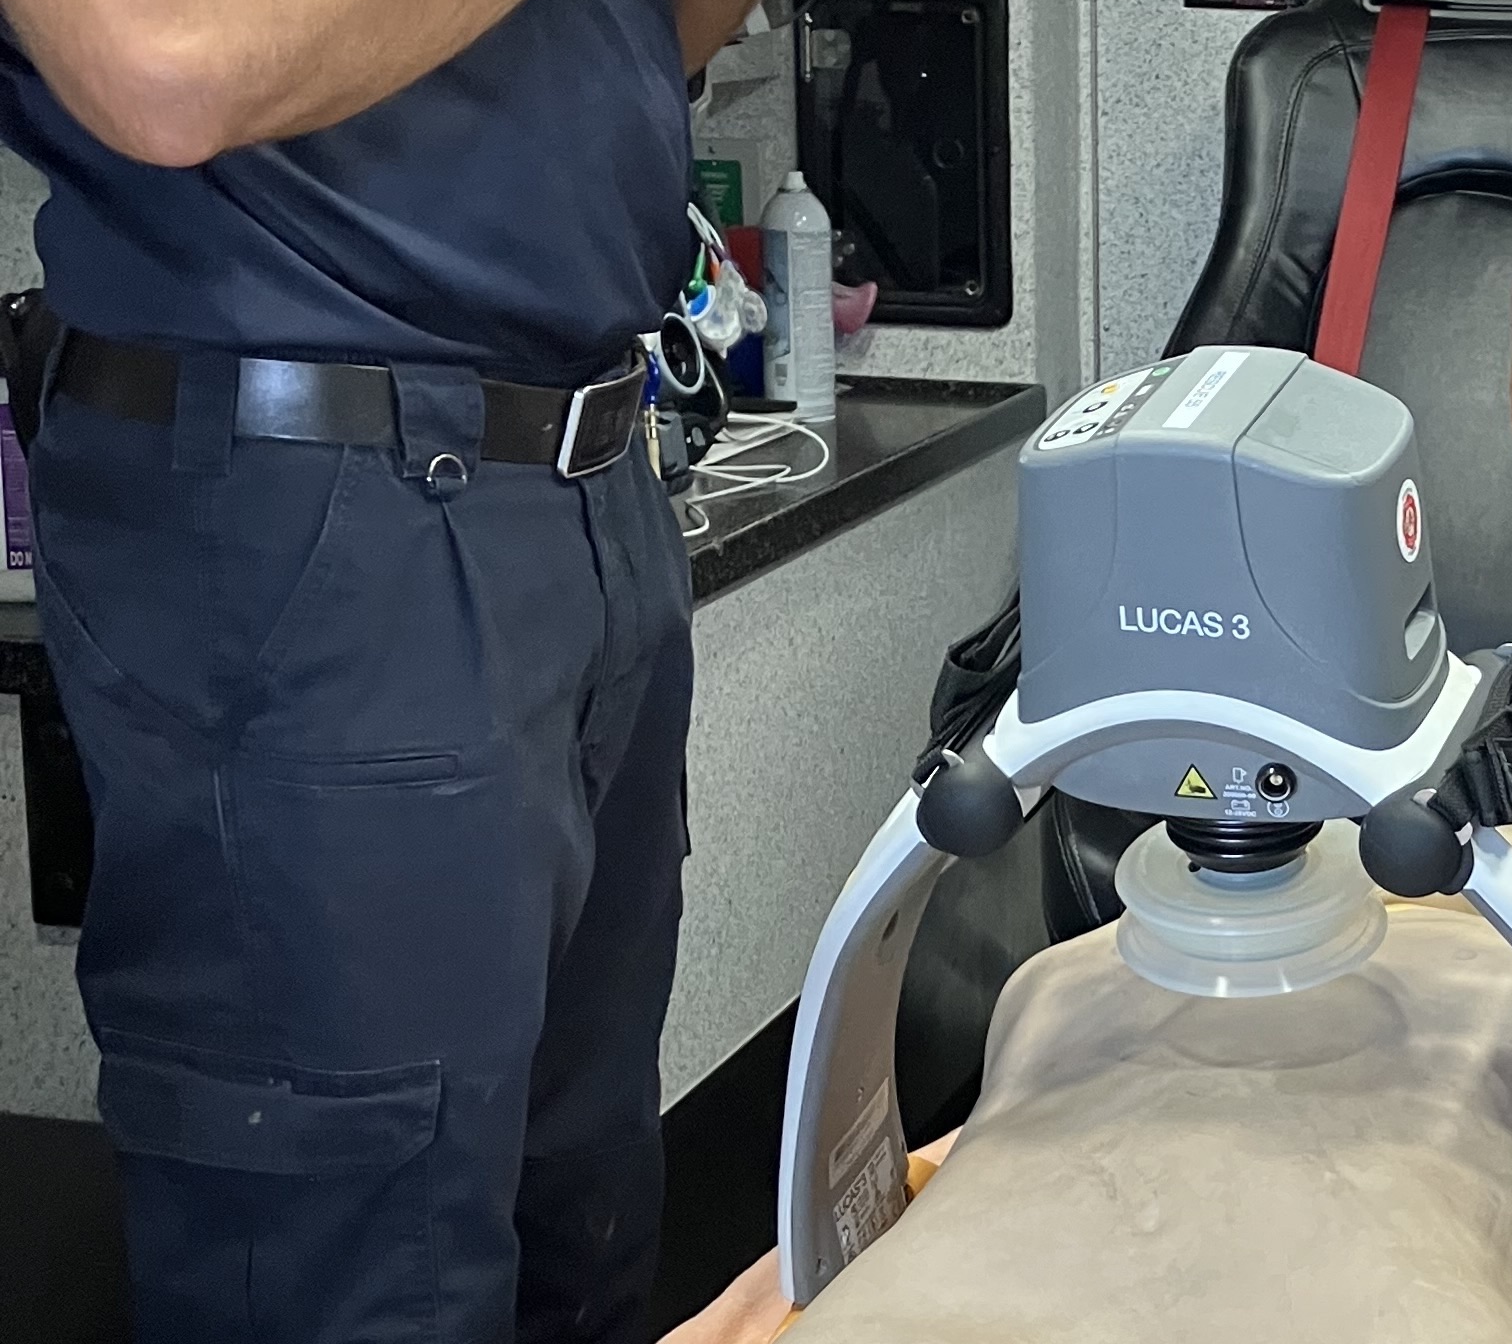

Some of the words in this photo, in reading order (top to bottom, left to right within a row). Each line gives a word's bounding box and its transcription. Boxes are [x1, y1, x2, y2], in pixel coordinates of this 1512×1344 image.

[10, 550, 24, 567] DO
[1119, 605, 1224, 638] LUCAS
[1232, 614, 1250, 640] 3
